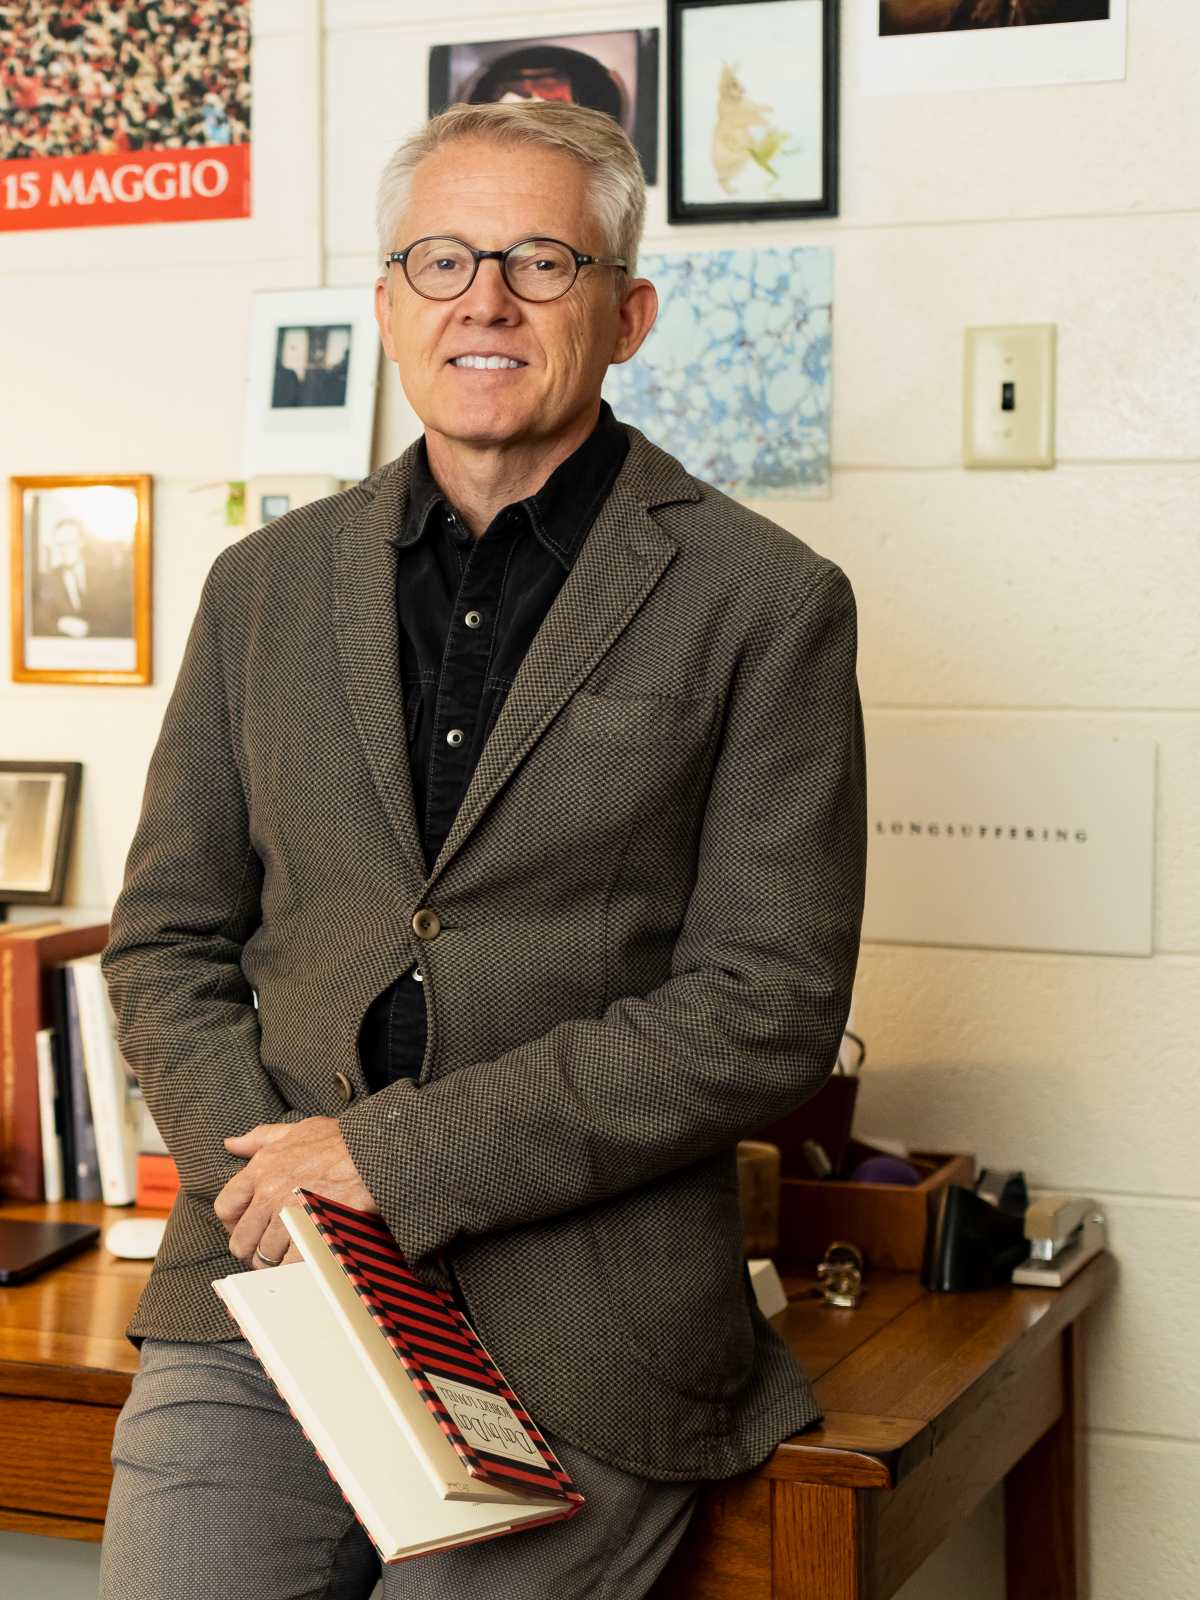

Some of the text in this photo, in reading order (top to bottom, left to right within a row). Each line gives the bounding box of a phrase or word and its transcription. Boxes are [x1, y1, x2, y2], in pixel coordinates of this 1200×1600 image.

[3, 158, 229, 211] 15 MAGGIO
[875, 820, 1089, 844] LONGSUFFERING
